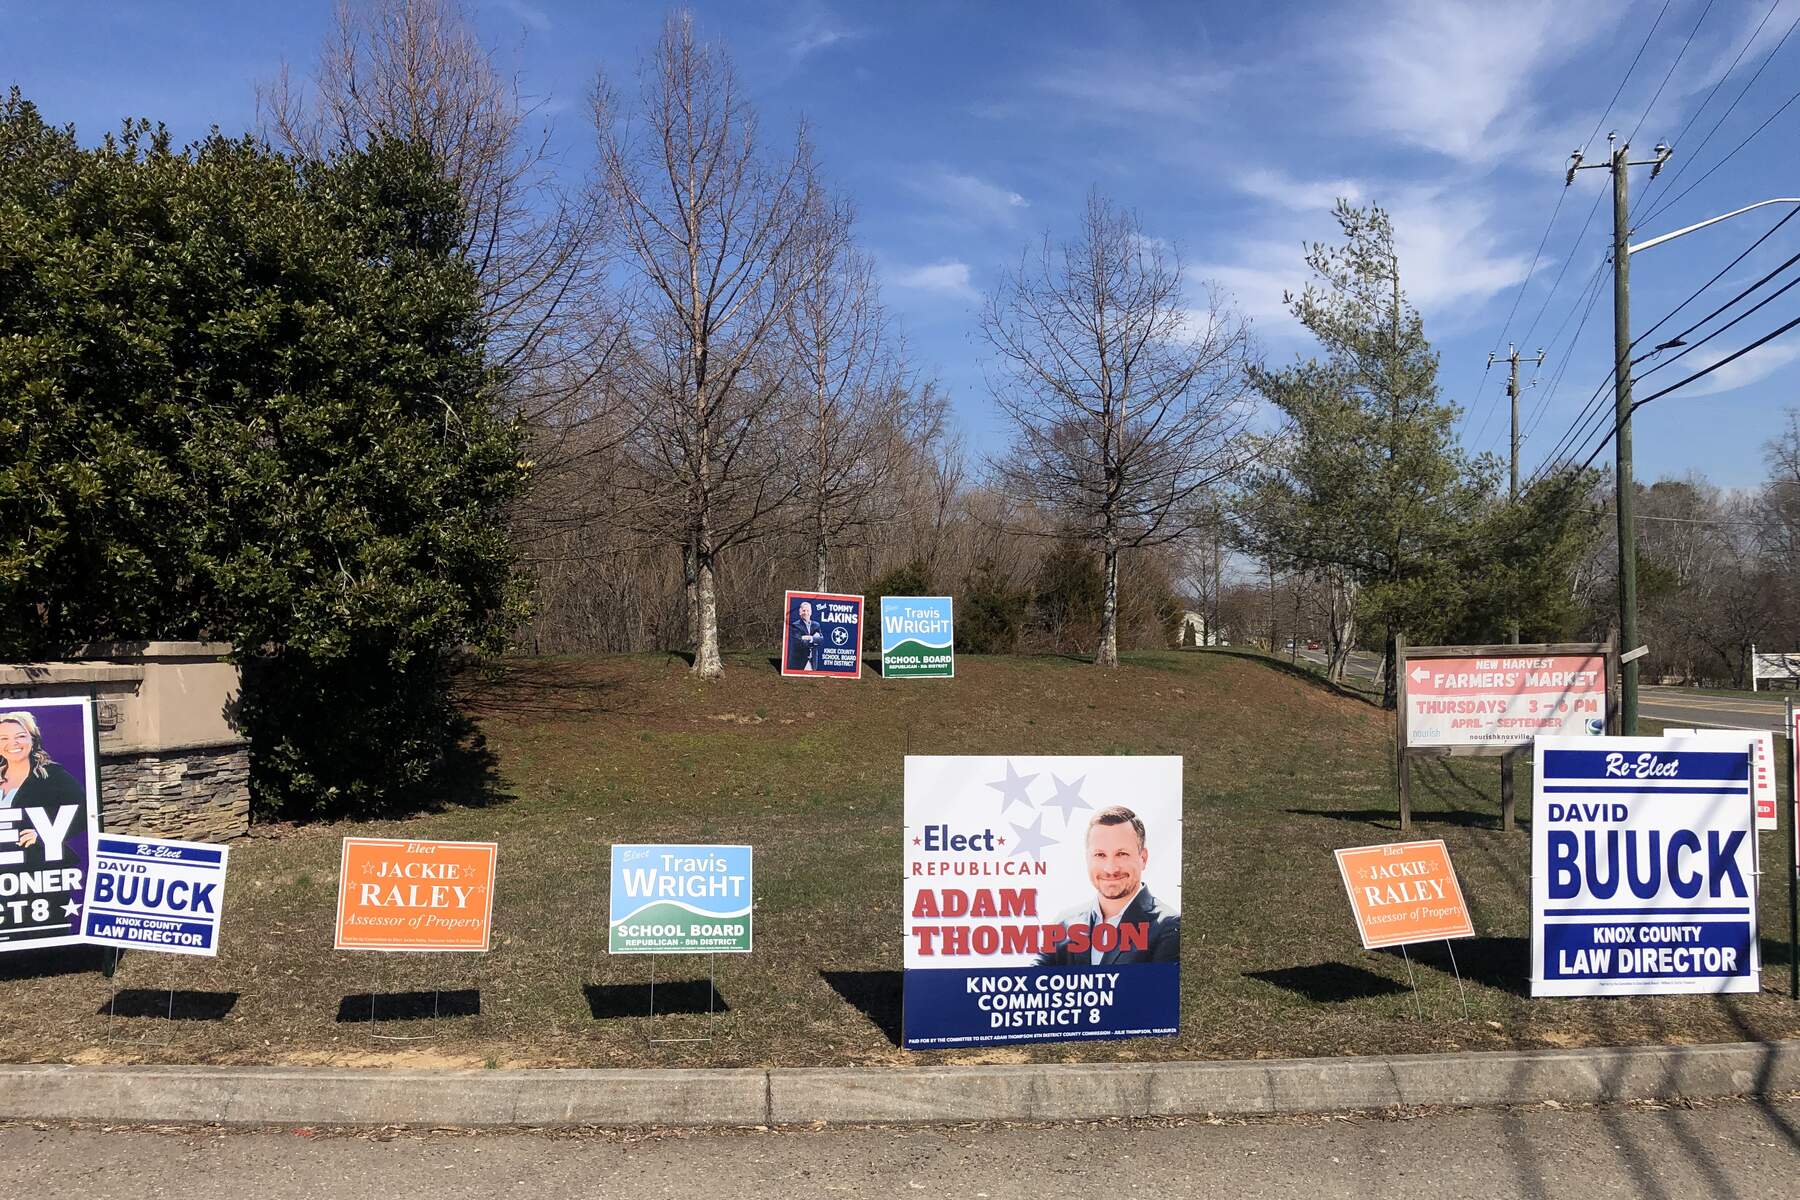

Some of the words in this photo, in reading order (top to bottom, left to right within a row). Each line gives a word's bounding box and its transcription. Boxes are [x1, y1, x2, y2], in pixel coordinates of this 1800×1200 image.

[828, 604, 854, 612] TOMMY
[904, 606, 940, 618] Travis
[821, 612, 858, 624] LAKINS
[885, 616, 950, 633] WRIGHT
[885, 656, 920, 664] SCHOOL
[1476, 660, 1498, 669] NEW
[1503, 659, 1554, 669] HARVEST
[1434, 672, 1520, 688] FARMERS'
[1525, 672, 1598, 686] MARKET
[1416, 700, 1506, 714] THURSDAYS
[1529, 700, 1538, 712] 3
[1574, 700, 1598, 712] PM
[1451, 718, 1482, 728] APRIL
[1497, 718, 1562, 728] SEPTEMBER
[1413, 728, 1440, 738] nourish
[1606, 753, 1679, 778] Re-Elect
[1549, 803, 1628, 822] DAVID
[924, 824, 994, 852] Elect
[136, 844, 182, 858] Re-Elect
[406, 844, 436, 854] Elect
[623, 850, 650, 862] Elect
[1383, 847, 1403, 857] Elect
[98, 861, 147, 874] DAVID
[376, 862, 460, 880] JACKIE
[660, 853, 727, 872] Travis
[912, 861, 1047, 876] REPUBLICAN
[1370, 861, 1429, 880] JACKIE
[1548, 829, 1749, 900] BUUCK
[622, 868, 745, 897] WRIGHT
[94, 872, 217, 914] BUUCK
[358, 883, 475, 909] RALEY
[1364, 879, 1446, 907] RALEY
[912, 888, 1038, 918] ADAM
[116, 917, 140, 927] KNOX
[143, 920, 182, 930] COUNTY
[345, 912, 406, 926] Assessor
[408, 912, 425, 930] of
[426, 915, 484, 930] Property
[1365, 912, 1407, 926] Assessor
[1410, 909, 1420, 922] of
[1423, 906, 1462, 920] Property
[94, 924, 125, 938] LAW
[128, 928, 202, 946] DIRECTOR
[618, 925, 685, 937] SCHOOL
[690, 924, 744, 937] BOARD
[912, 922, 1150, 956] THOMPSON
[1594, 927, 1635, 944] KNOX
[1639, 926, 1702, 943] COUNTY
[1559, 949, 1610, 975] LAW
[1618, 947, 1737, 974] DIRECTOR
[966, 976, 1028, 993] KNOX
[1035, 973, 1120, 992] COUNTY
[978, 991, 1114, 1011] COMMISSION
[990, 1010, 1082, 1028] DISTRICT
[1089, 1009, 1100, 1024] 8
